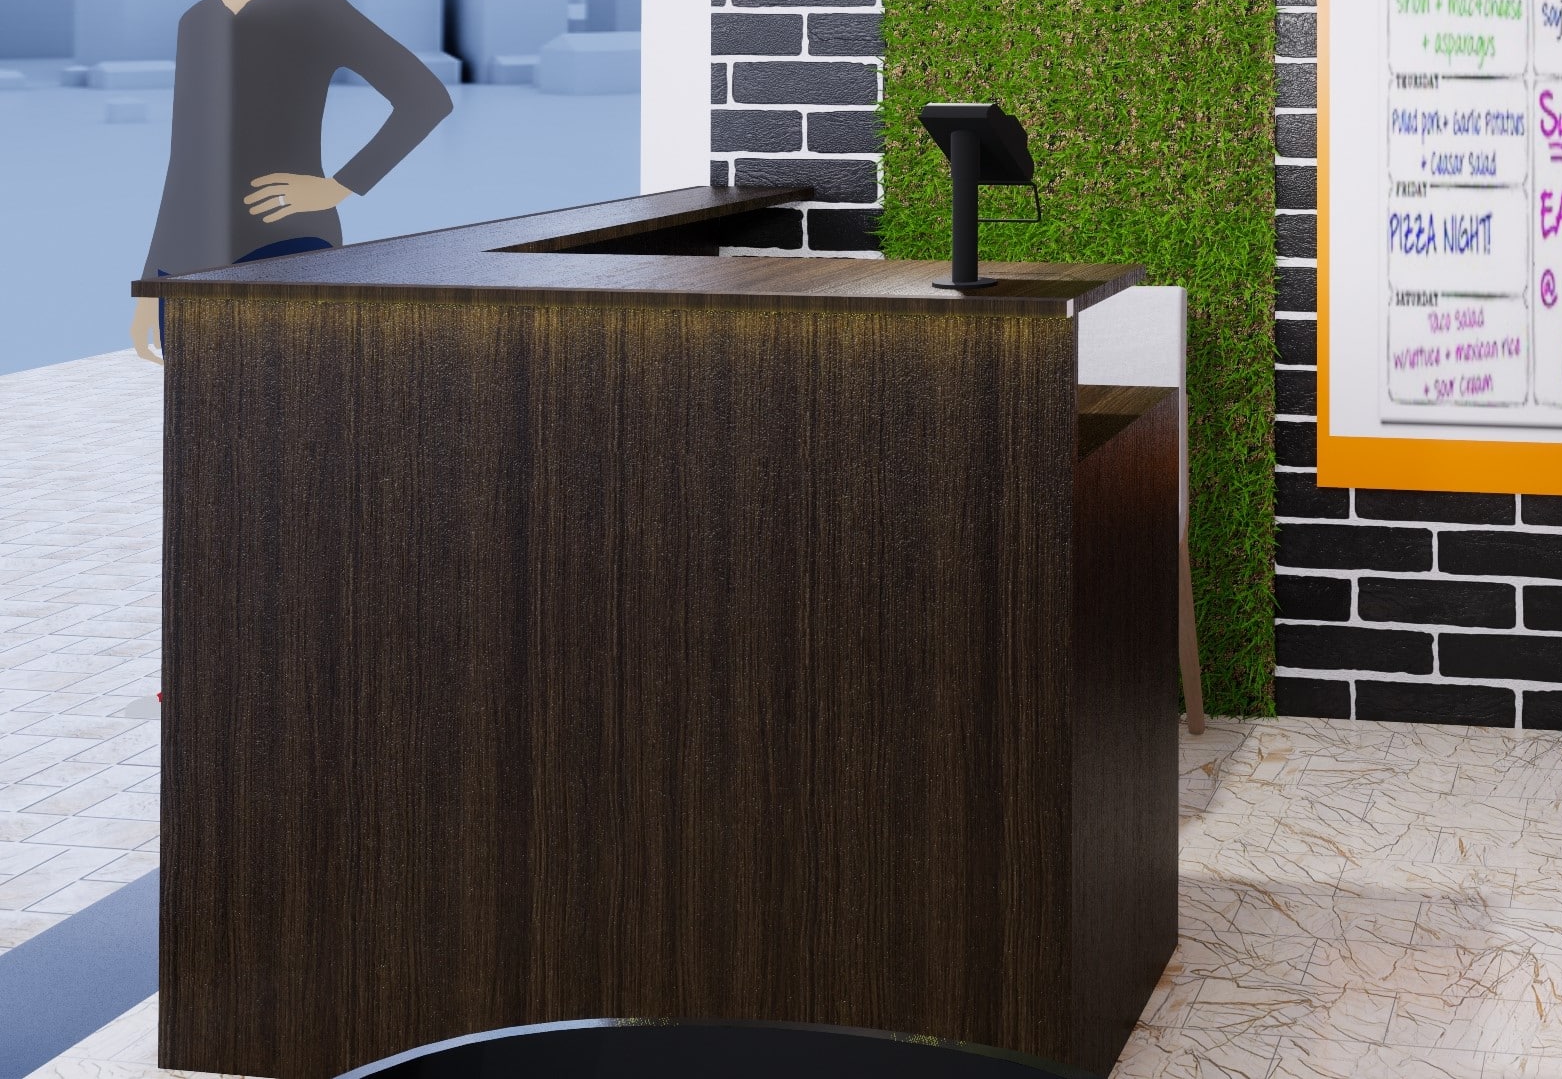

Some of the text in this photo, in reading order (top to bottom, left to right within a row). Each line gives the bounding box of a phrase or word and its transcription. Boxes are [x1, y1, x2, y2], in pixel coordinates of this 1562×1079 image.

[1395, 73, 1439, 89] THURSDAY
[1395, 181, 1427, 197] FRIDAY
[1389, 211, 1493, 257] PIZZA NIGHT!
[1540, 268, 1558, 308] @
[1395, 290, 1439, 307] SATURDAY
